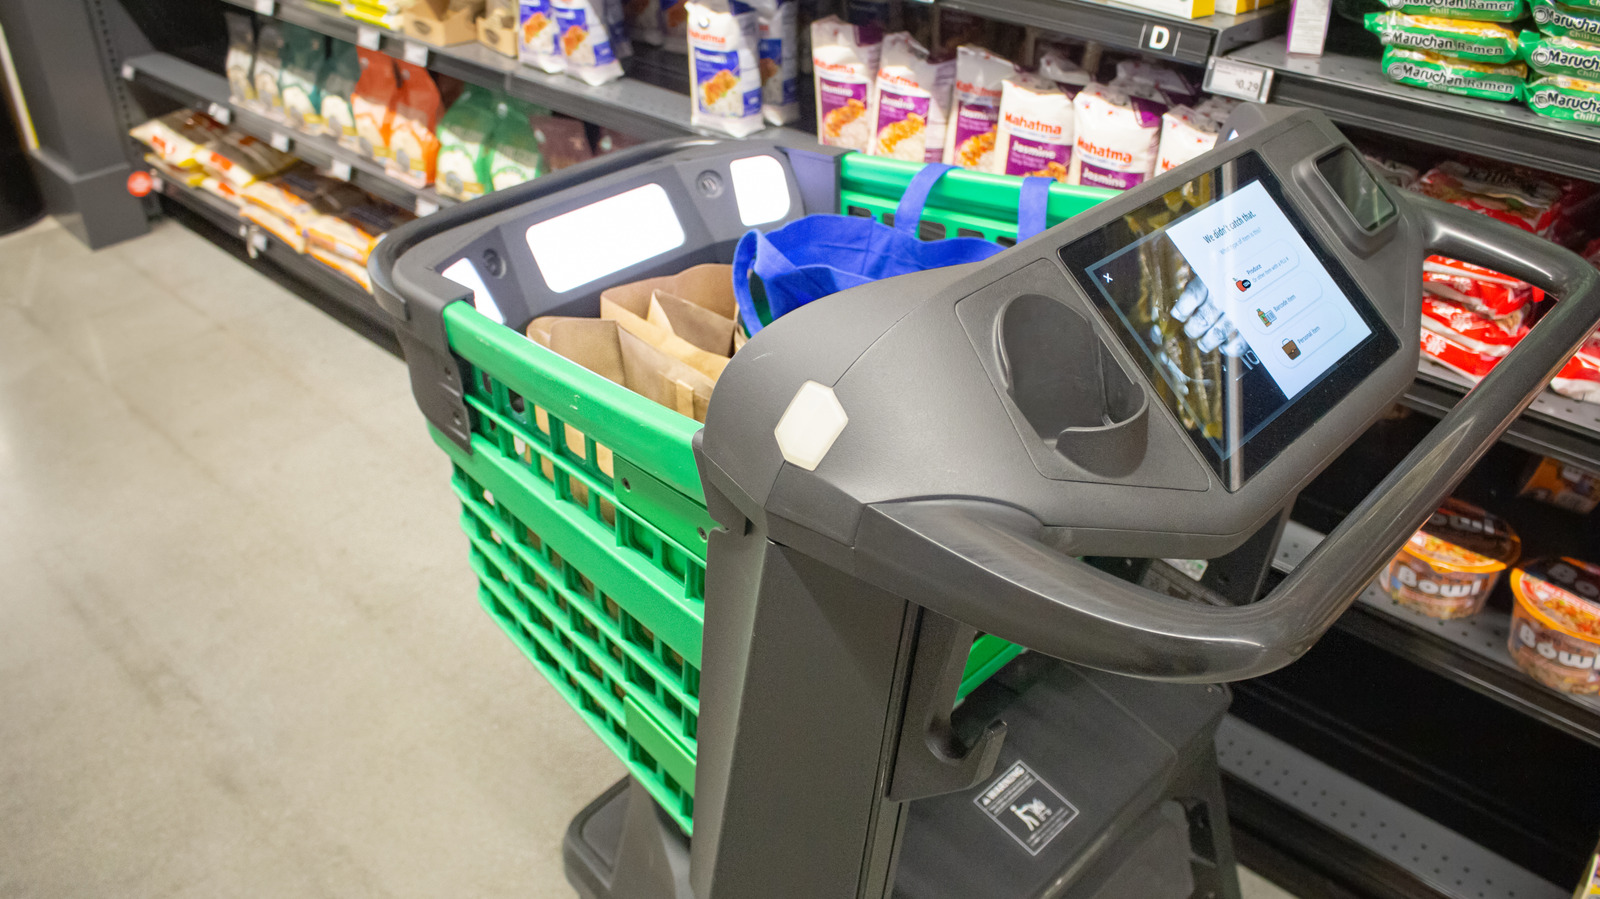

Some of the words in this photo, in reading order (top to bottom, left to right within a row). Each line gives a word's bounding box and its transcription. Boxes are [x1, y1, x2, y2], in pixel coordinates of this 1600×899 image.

[1546, 8, 1600, 34] Marucha
[1149, 25, 1170, 50] D
[1393, 32, 1453, 49] Maruchan
[1457, 41, 1503, 55] Ramen
[1549, 50, 1600, 70] Maruch
[1403, 64, 1463, 86] Maruchan
[1468, 78, 1513, 94] Ramen
[1005, 112, 1062, 135] Mahatma
[1012, 140, 1056, 160] Jasmine
[1078, 136, 1133, 163] Mahatma
[1083, 167, 1126, 188] Jasmine
[1203, 234, 1215, 243] We
[1213, 225, 1231, 239] didn't
[1229, 216, 1244, 230] catch
[1241, 210, 1256, 222] that.
[1246, 264, 1262, 275] Produce
[1273, 300, 1289, 312] Barcode
[1286, 294, 1297, 303] item
[1297, 330, 1313, 344] Personal
[1311, 325, 1321, 334] item
[1398, 564, 1482, 598] Bowl
